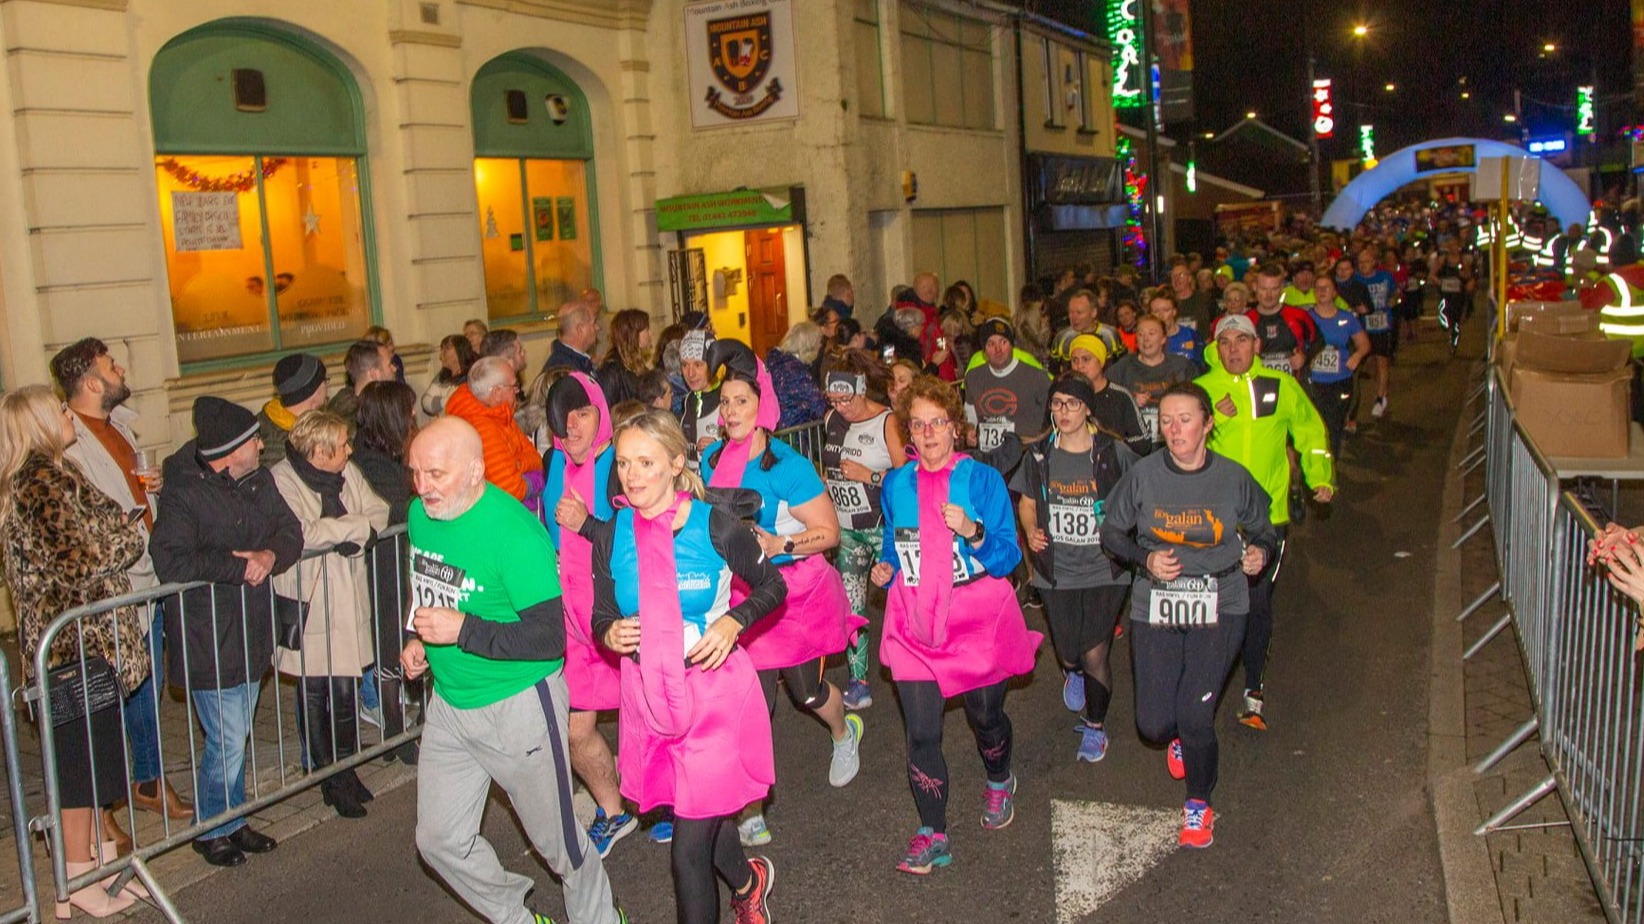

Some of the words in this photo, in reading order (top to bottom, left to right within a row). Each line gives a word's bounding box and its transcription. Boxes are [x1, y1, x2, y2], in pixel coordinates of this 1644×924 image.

[710, 18, 750, 32] MOUNTAIN
[750, 15, 768, 26] ASH
[660, 202, 700, 213] MOUNTAIN
[701, 200, 716, 209] ASH
[176, 325, 261, 342] NTERTAINMENT
[1165, 512, 1202, 528] galan
